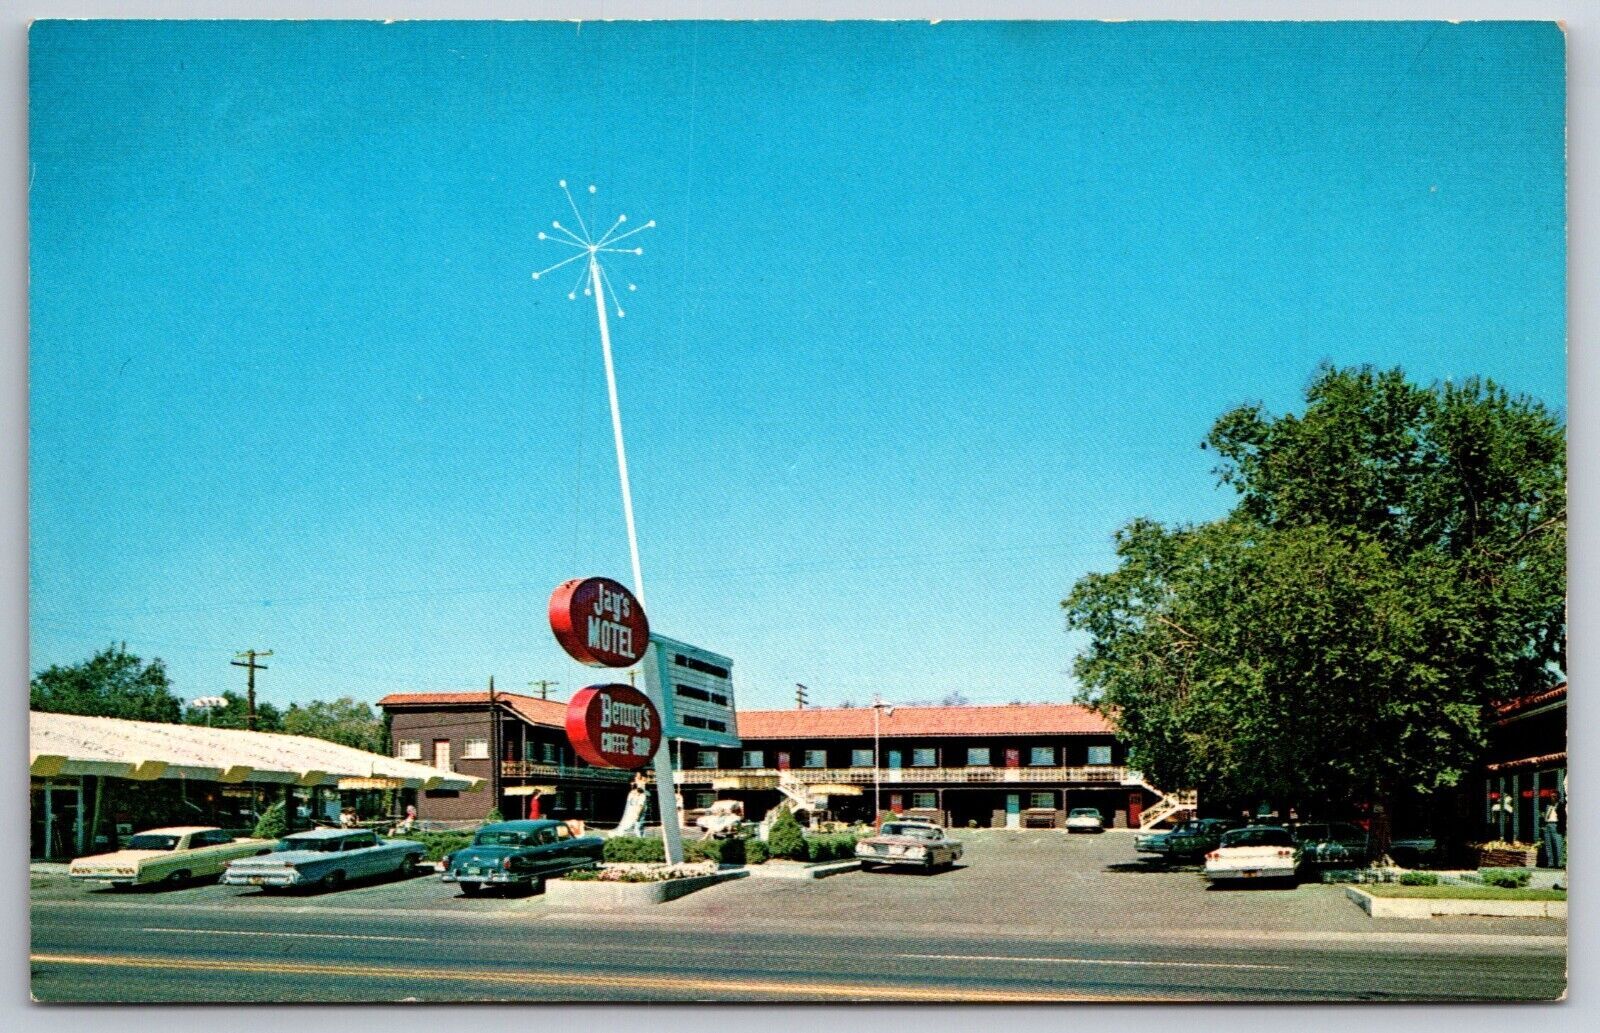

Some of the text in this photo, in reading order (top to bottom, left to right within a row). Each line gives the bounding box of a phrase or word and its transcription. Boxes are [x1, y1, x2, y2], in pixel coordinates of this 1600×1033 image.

[594, 583, 630, 622] Jay's
[588, 615, 636, 659] MOTEL
[600, 693, 650, 733] Benny's
